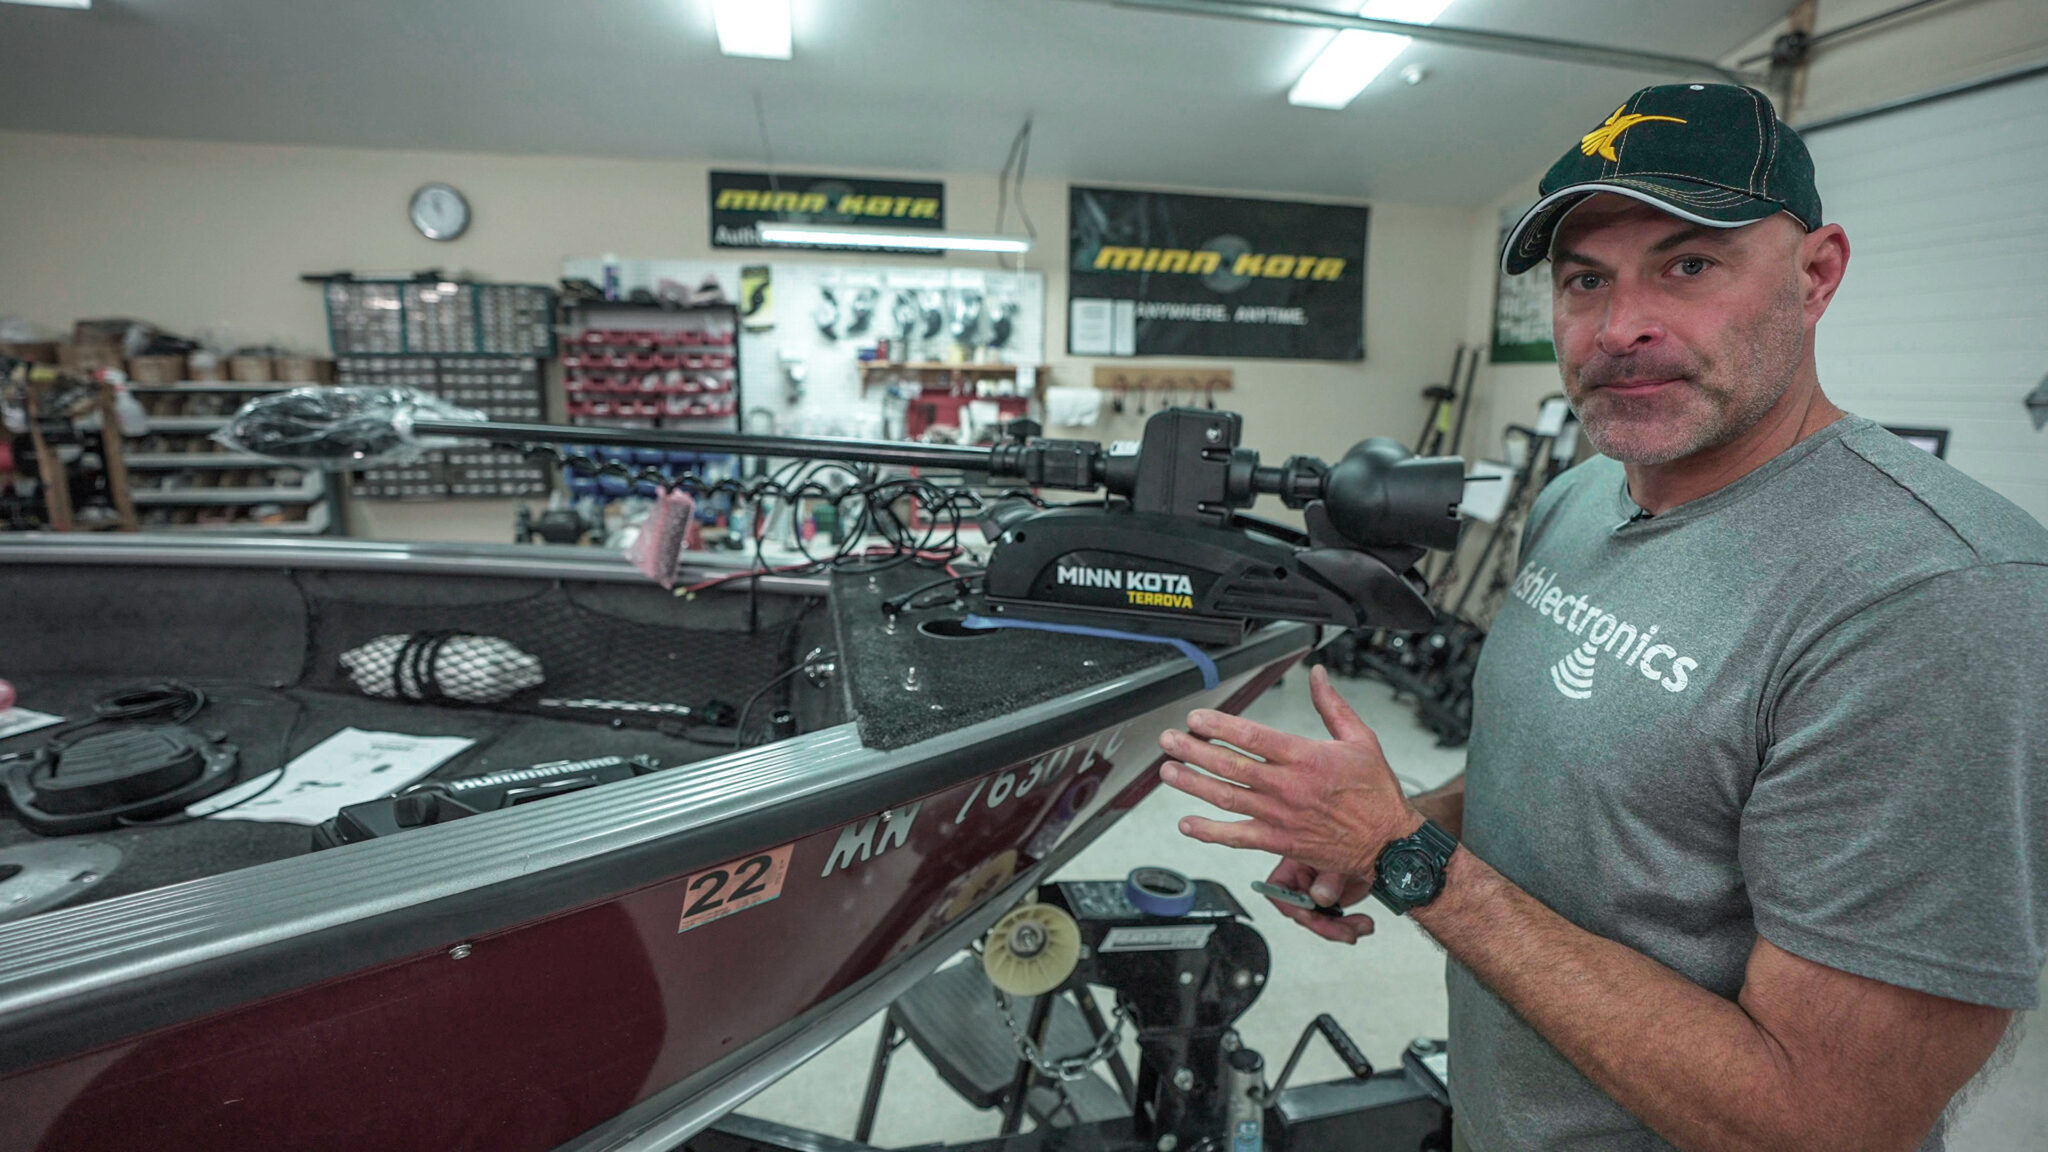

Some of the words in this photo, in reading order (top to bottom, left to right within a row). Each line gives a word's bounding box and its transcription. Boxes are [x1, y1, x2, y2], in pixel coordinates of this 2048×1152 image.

[1057, 565, 1122, 589] MINN
[1126, 570, 1194, 595] KOTA
[1127, 590, 1193, 609] TERROVA
[821, 800, 923, 878] MN
[682, 854, 773, 919] 22
